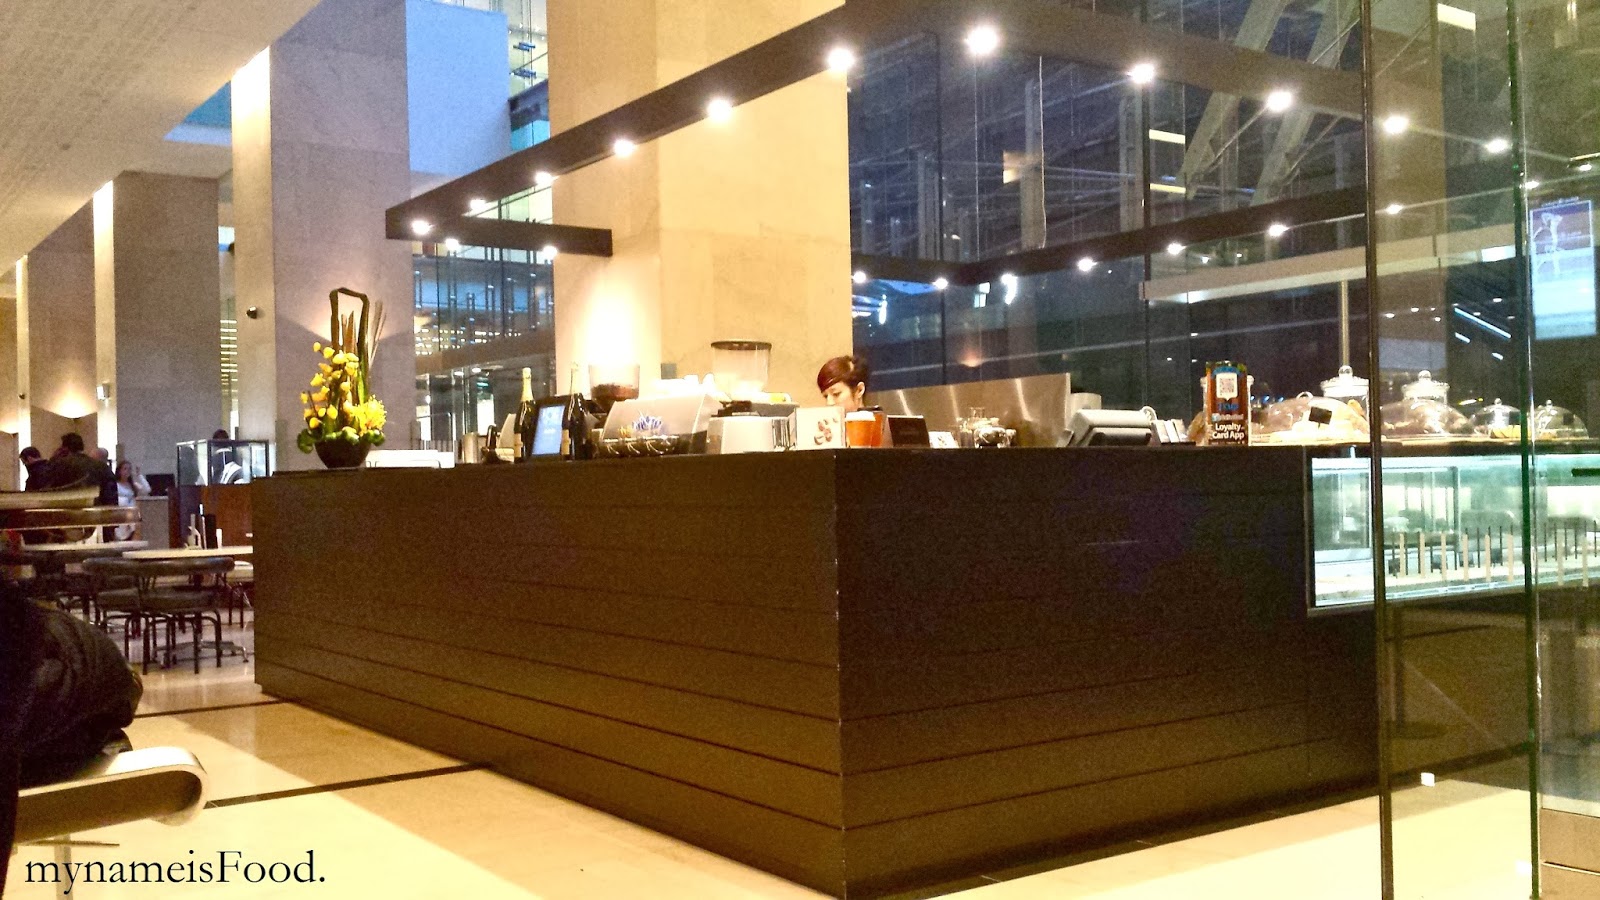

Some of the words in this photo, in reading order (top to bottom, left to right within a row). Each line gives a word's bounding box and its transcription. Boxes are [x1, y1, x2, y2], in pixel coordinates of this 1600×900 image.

[1215, 422, 1241, 432] Loyalty
[1212, 431, 1229, 439] Card
[1230, 431, 1245, 440] App
